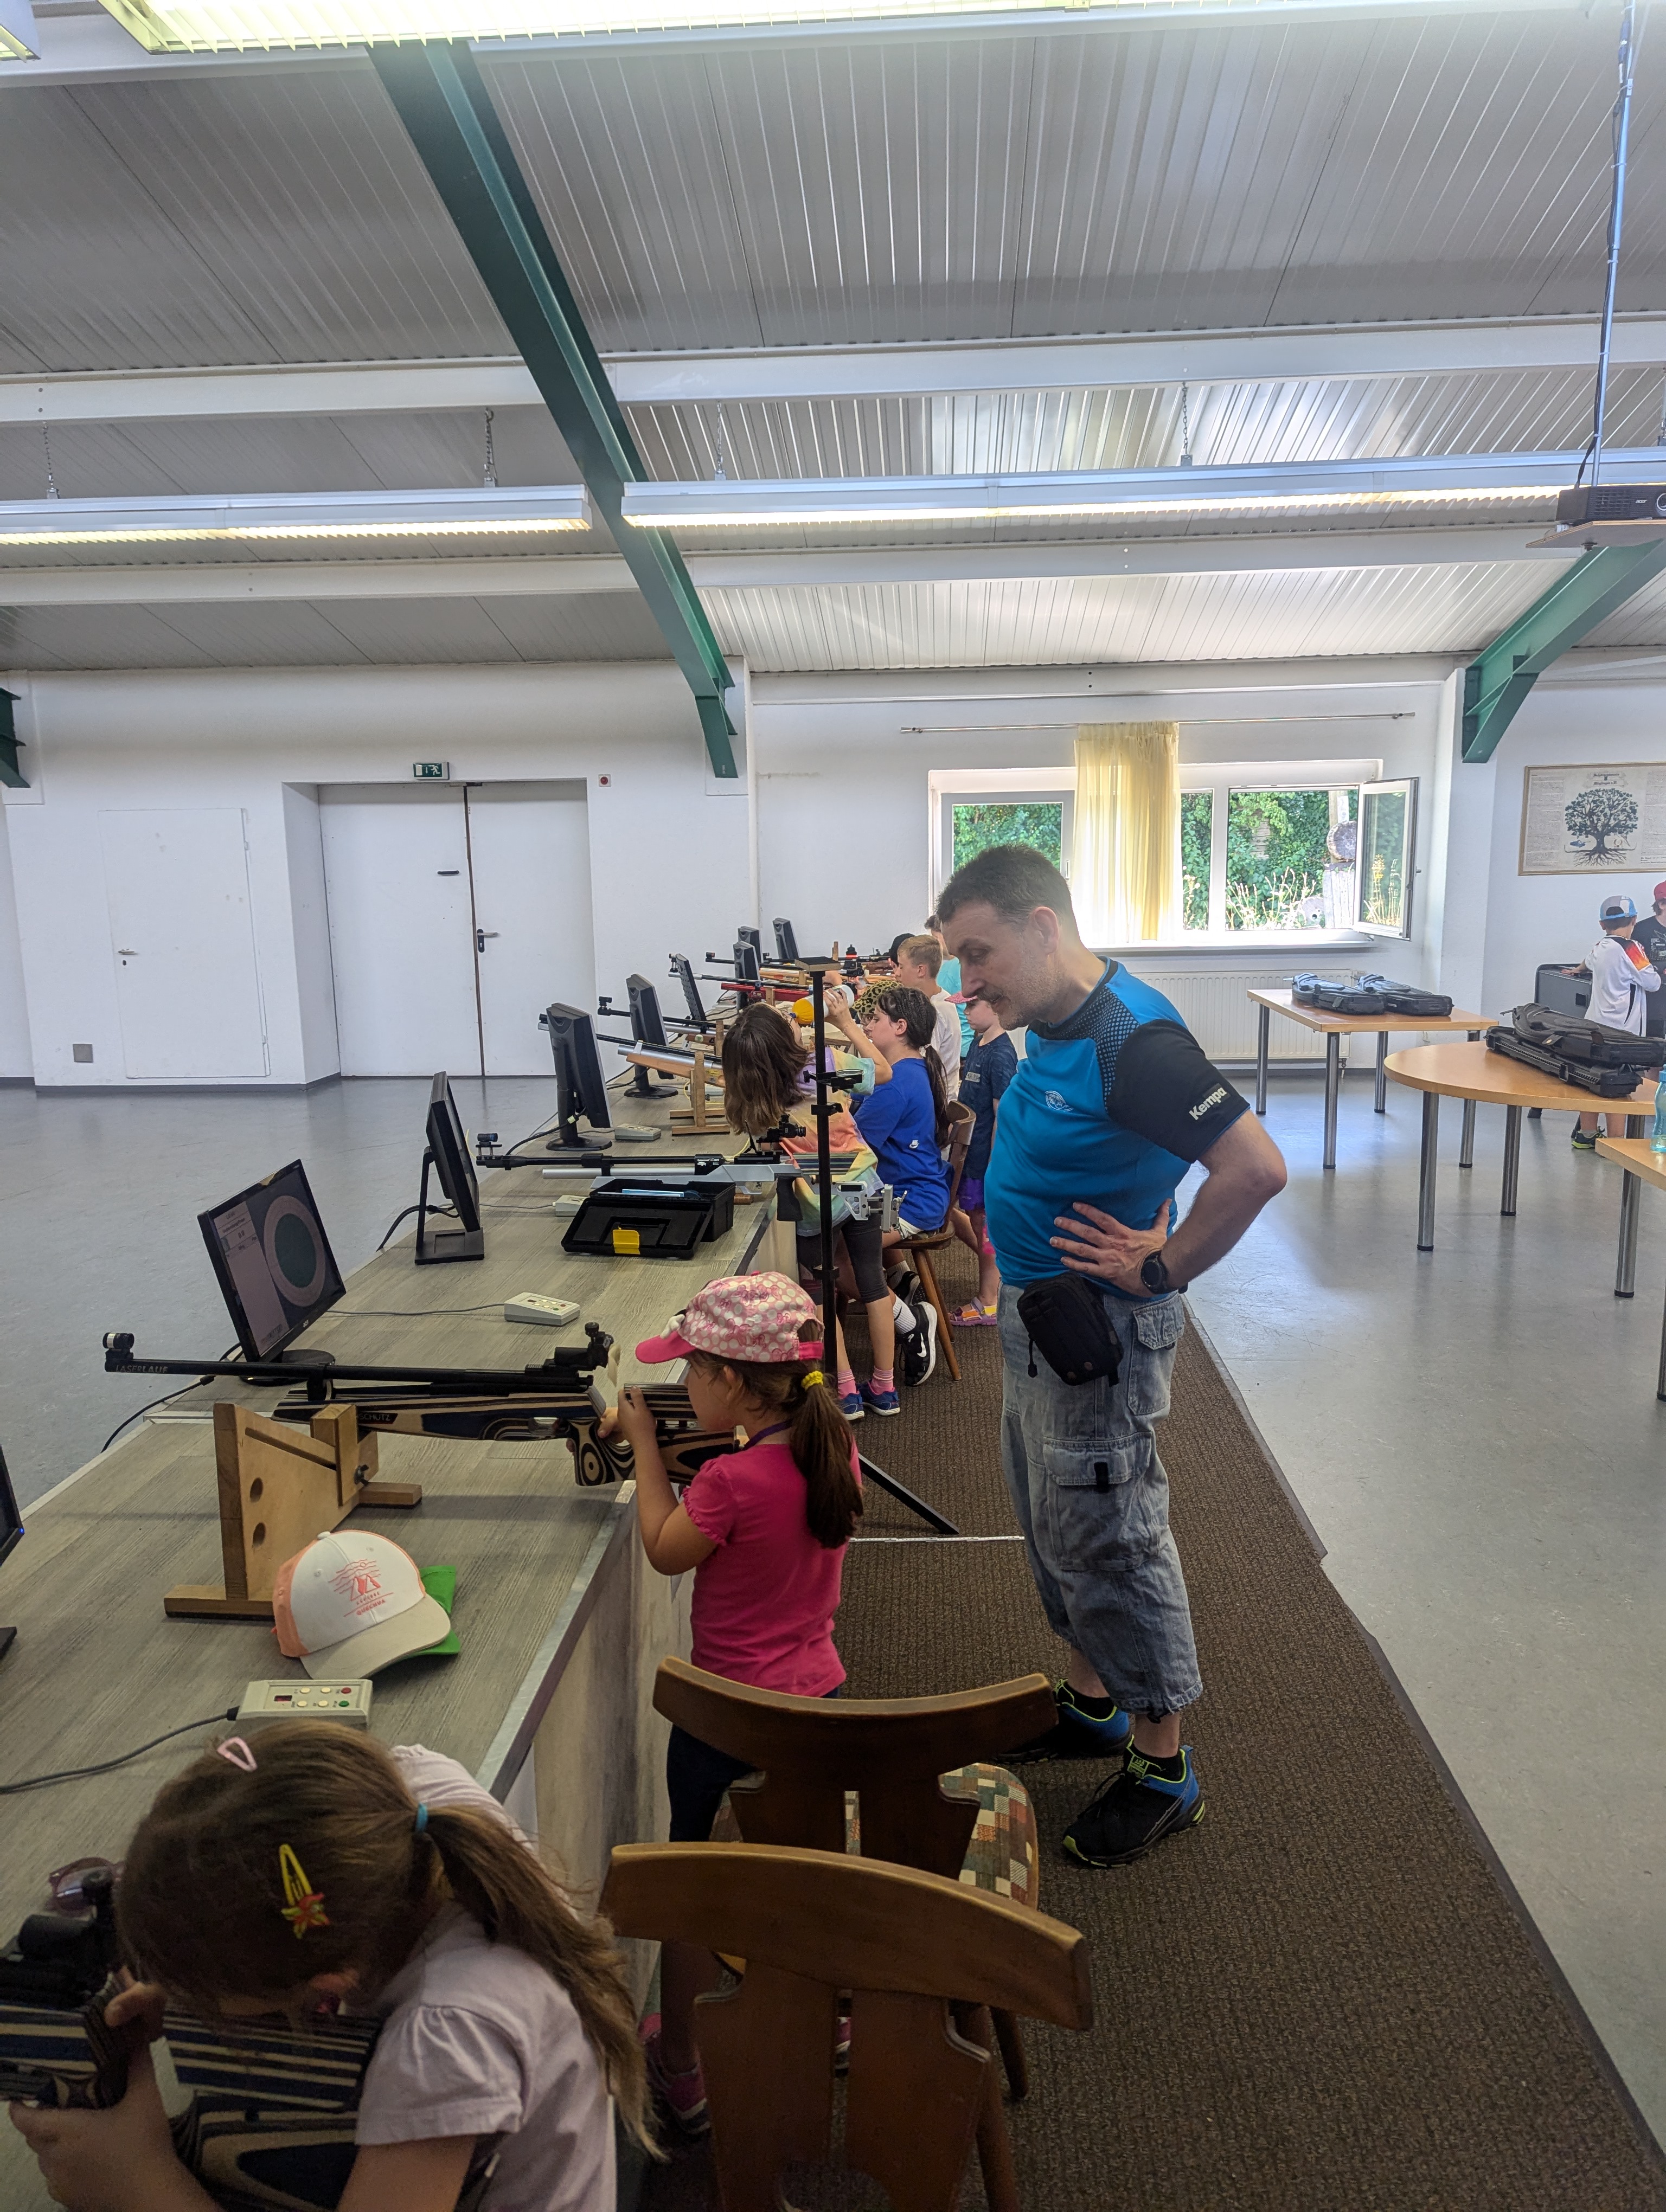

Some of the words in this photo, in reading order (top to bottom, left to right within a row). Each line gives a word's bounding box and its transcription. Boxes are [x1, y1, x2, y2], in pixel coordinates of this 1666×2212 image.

[1189, 1086, 1227, 1121] Kempa
[116, 1365, 168, 1373] LASERLAUF
[358, 1413, 390, 1422] SCHUTZ
[356, 1599, 386, 1616] QUECHUA
